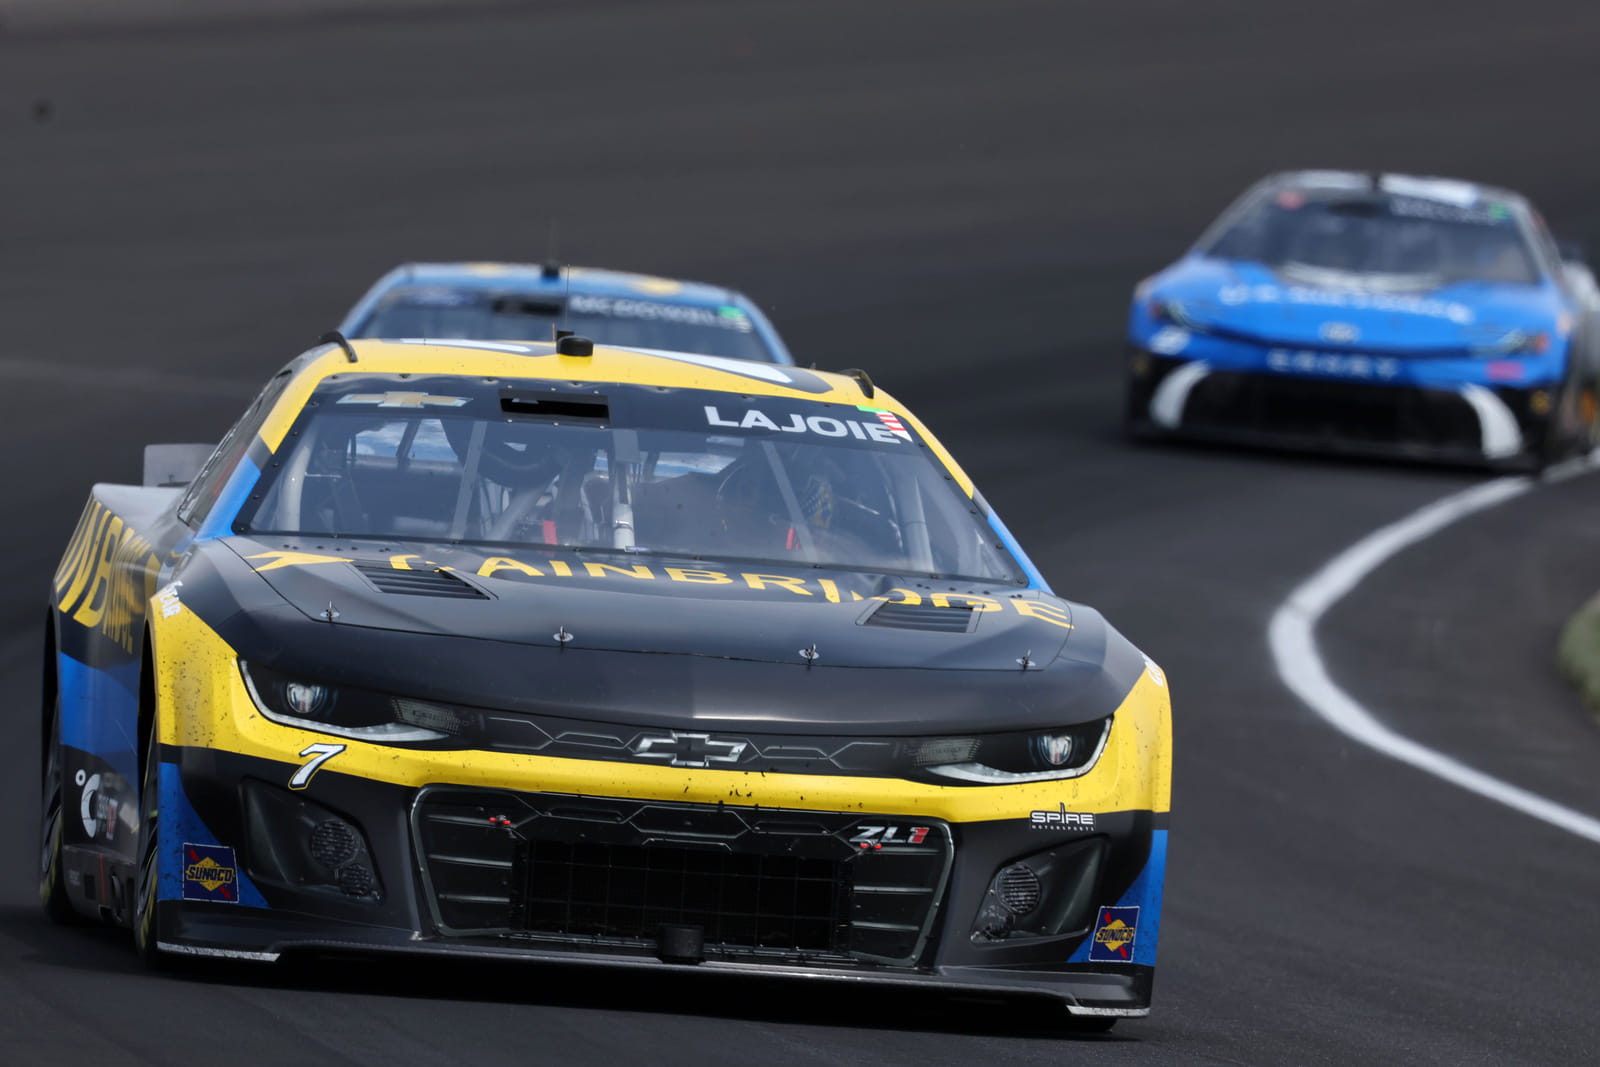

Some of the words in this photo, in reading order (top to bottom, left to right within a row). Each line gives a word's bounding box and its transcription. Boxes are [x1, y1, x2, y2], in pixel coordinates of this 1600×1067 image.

[704, 406, 901, 443] LAJOIE
[289, 743, 347, 790] 7
[1031, 802, 1094, 825] SPIRE
[849, 826, 929, 843] ZL1
[187, 865, 234, 883] SUNOCO
[1096, 927, 1134, 943] SUNOCO
